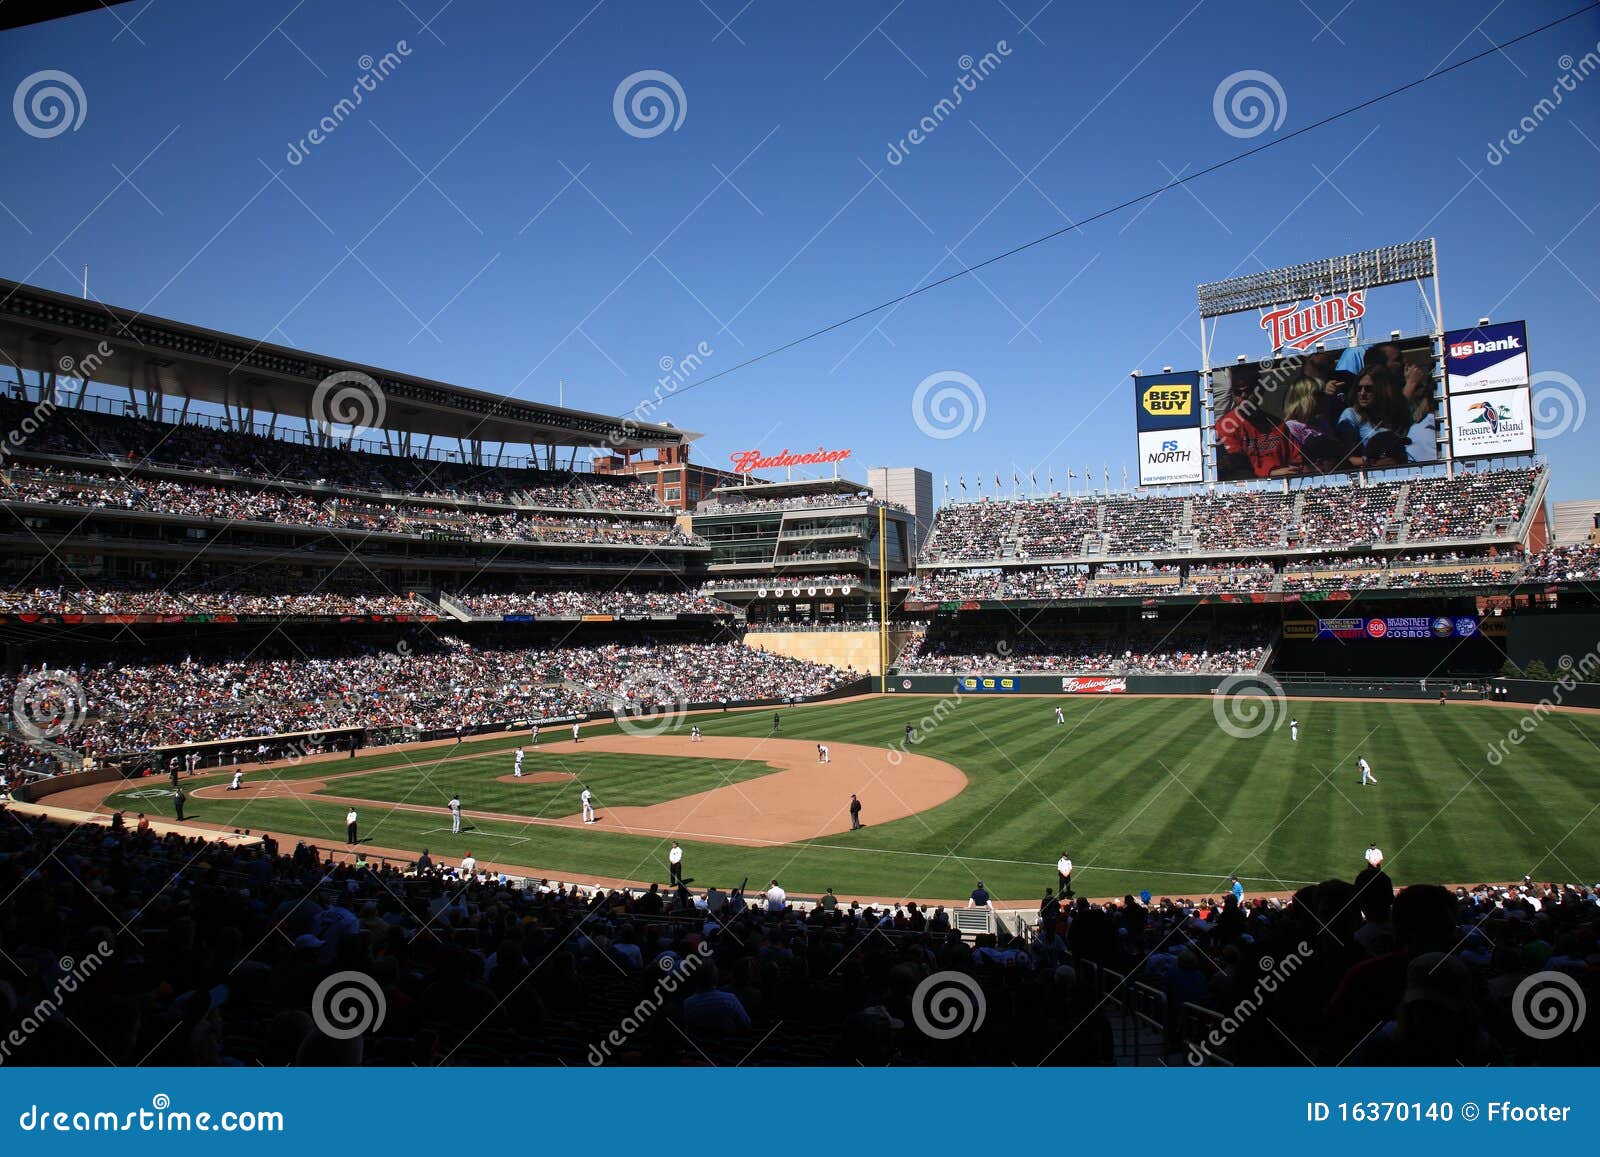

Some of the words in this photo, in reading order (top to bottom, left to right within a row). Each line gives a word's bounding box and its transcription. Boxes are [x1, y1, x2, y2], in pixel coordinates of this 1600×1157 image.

[1260, 290, 1366, 352] Twins
[1149, 391, 1190, 400] BEST
[1150, 401, 1186, 410] BUY
[1457, 425, 1491, 436] Treasure
[1499, 420, 1524, 432] Island
[1162, 440, 1178, 452] FS
[730, 446, 851, 473] Budweiser
[1148, 451, 1191, 464] NORTH
[1369, 623, 1384, 631] 508
[1387, 618, 1429, 627] BRADSTREET
[1068, 677, 1121, 692] Budweiser
